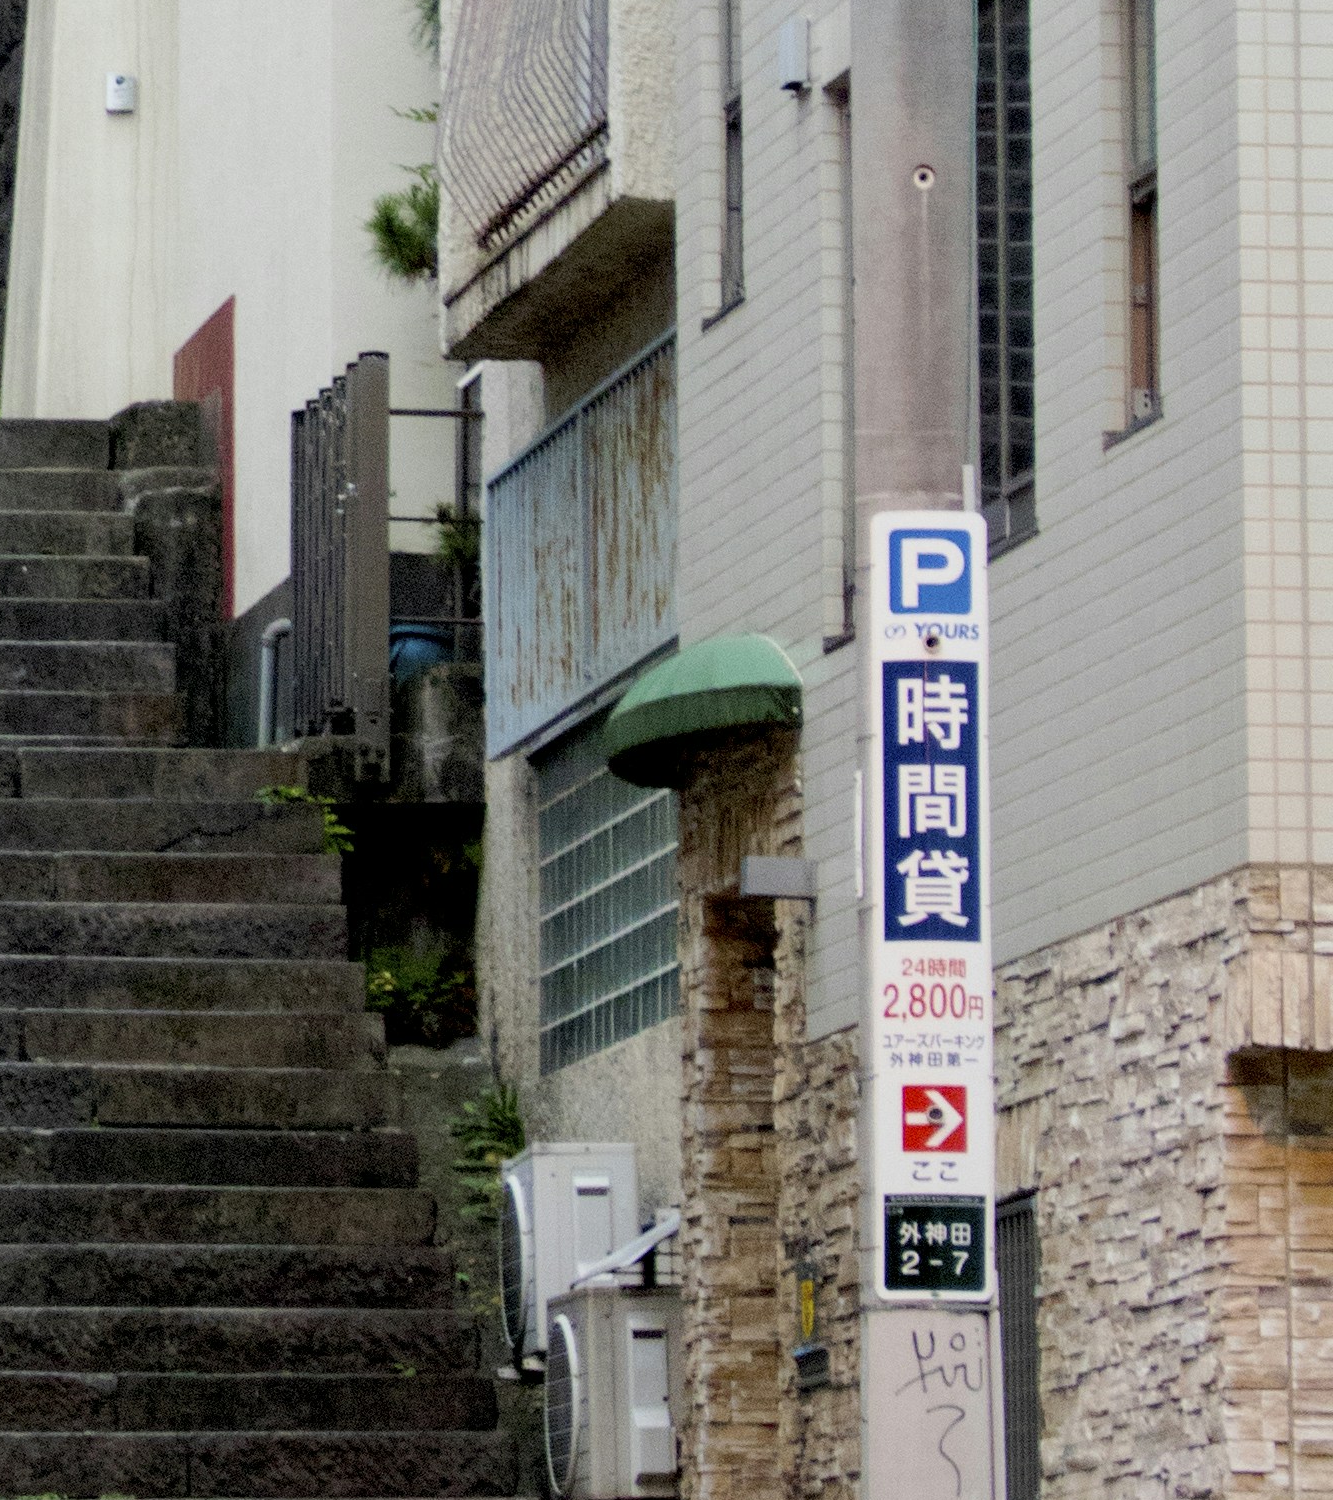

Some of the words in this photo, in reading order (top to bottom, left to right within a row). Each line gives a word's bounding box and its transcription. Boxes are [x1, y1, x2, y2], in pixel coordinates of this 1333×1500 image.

[901, 537, 965, 609] P
[915, 622, 979, 640] YOURS
[896, 674, 970, 928] 時間貸
[902, 958, 967, 978] 24時間
[883, 983, 983, 1021] 2,800円
[912, 1161, 960, 1182] ここ
[899, 1221, 972, 1247] 外神田
[900, 1249, 970, 1277] 2-7
